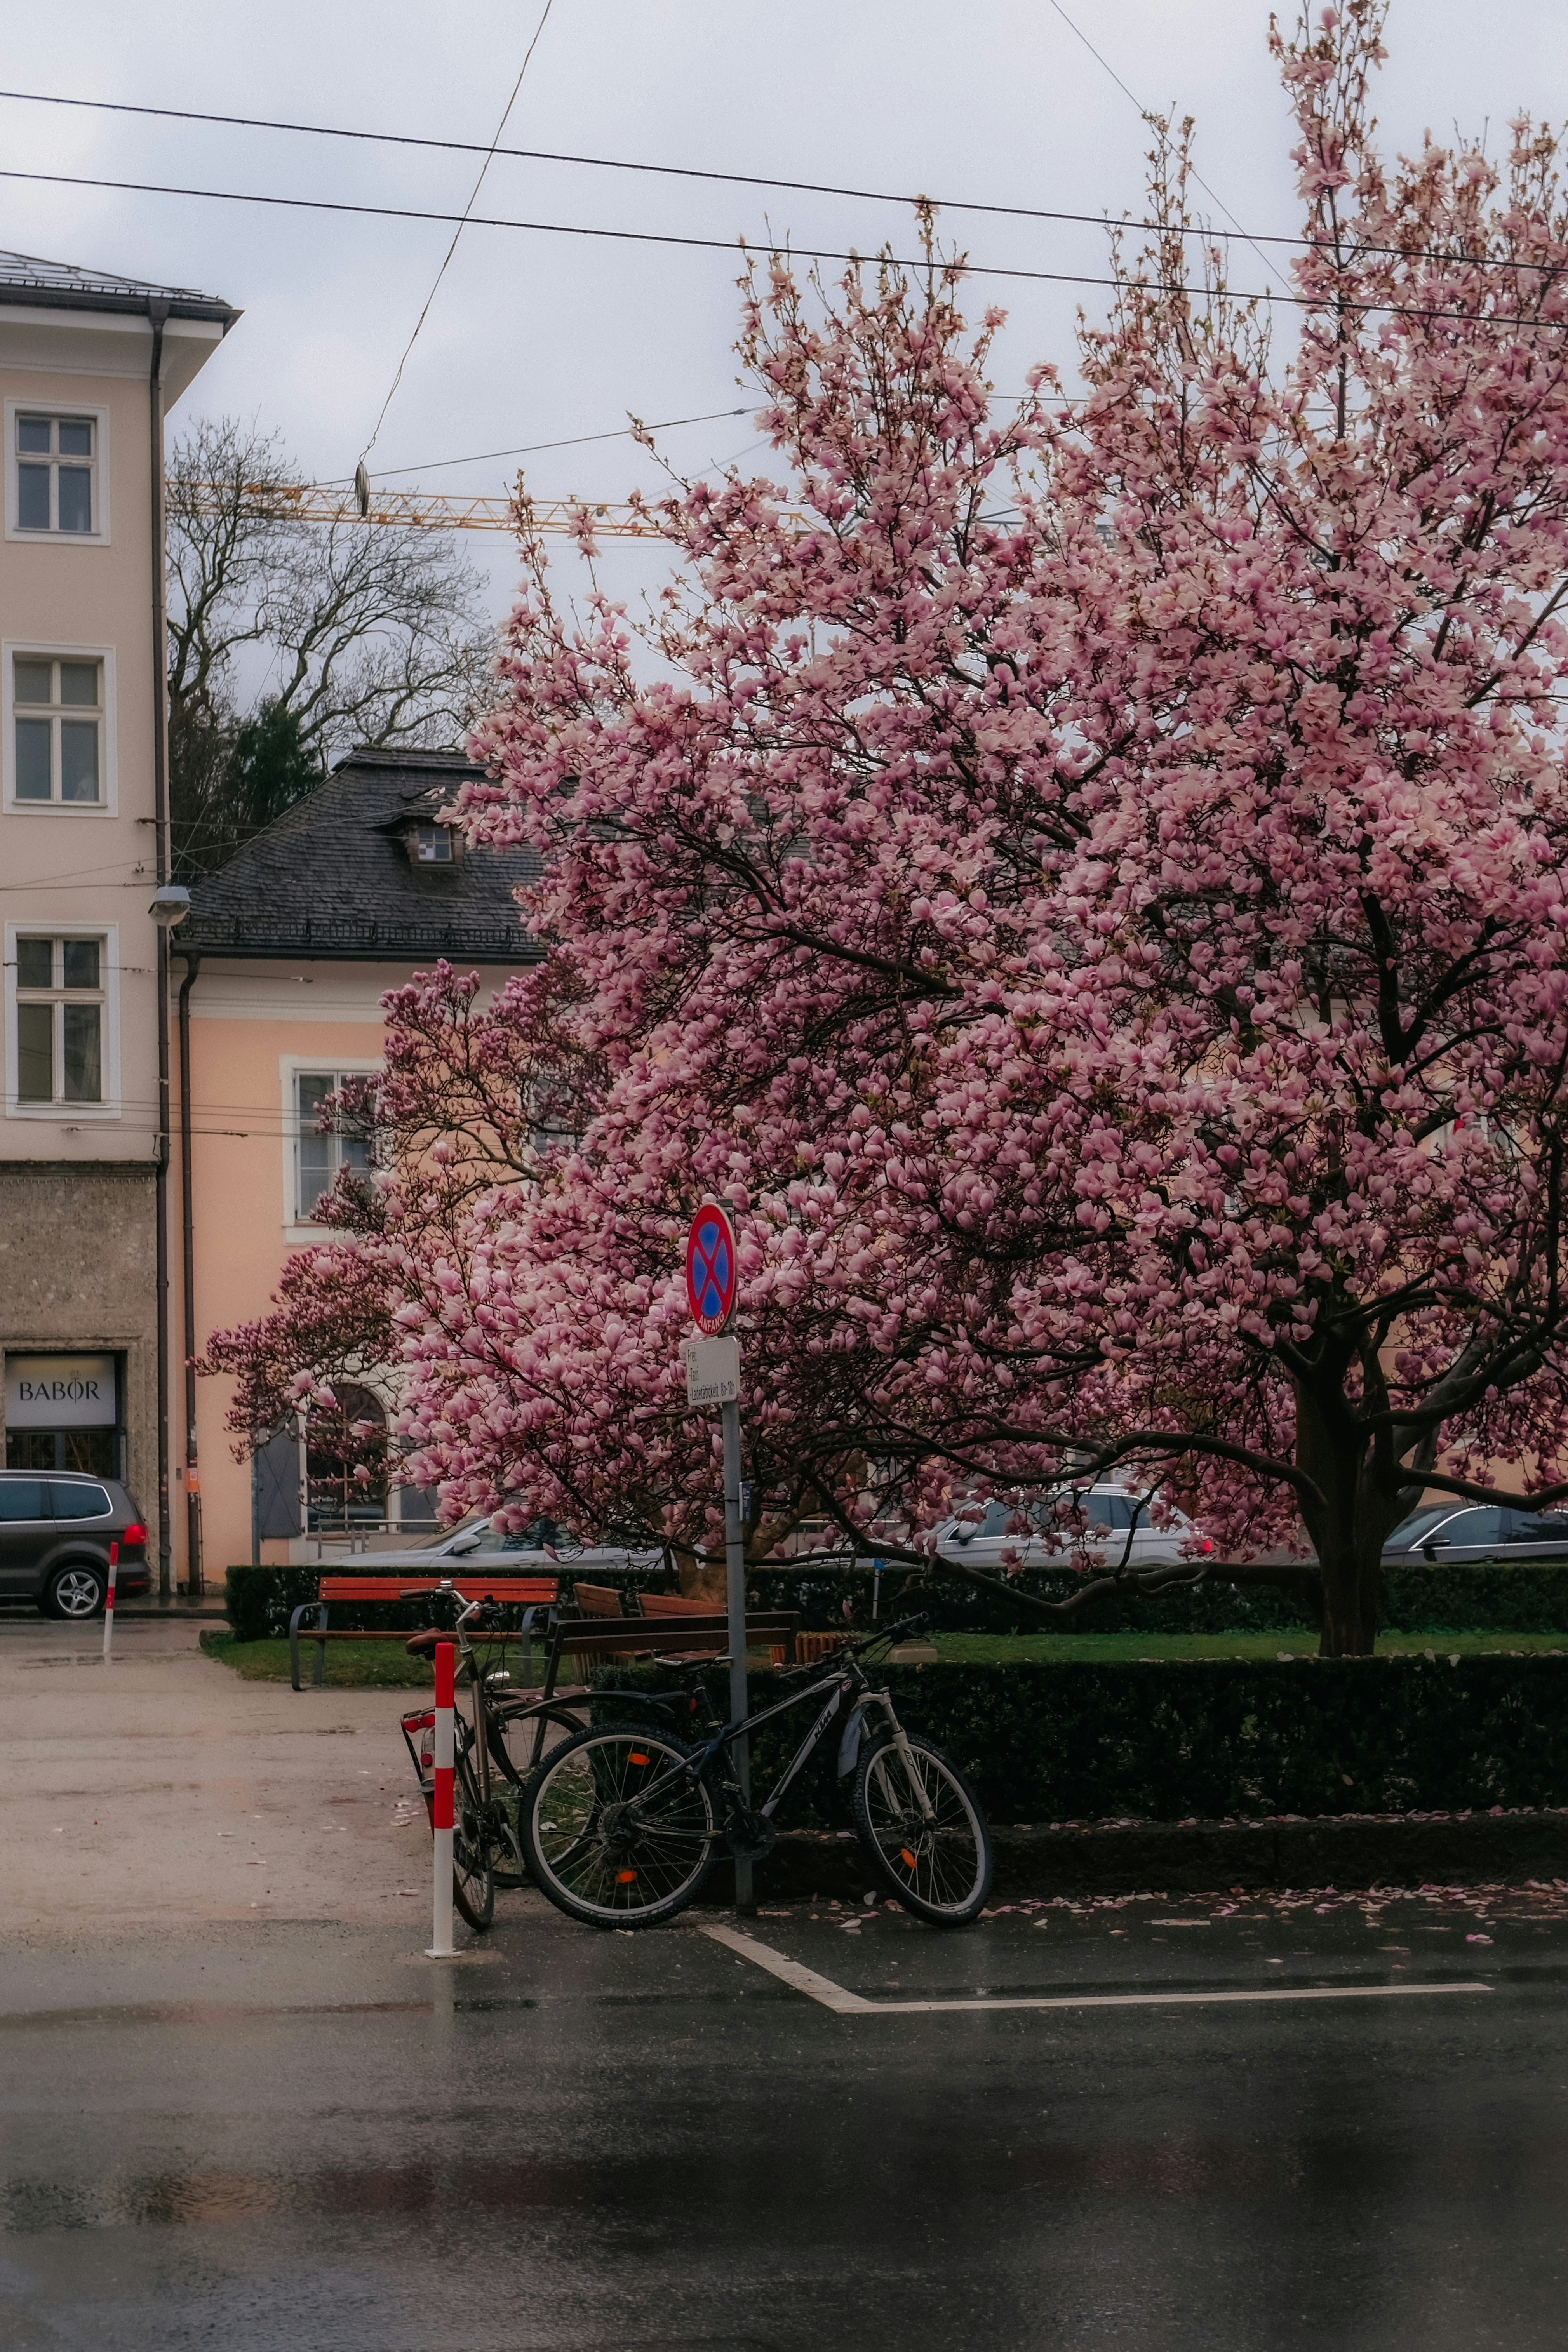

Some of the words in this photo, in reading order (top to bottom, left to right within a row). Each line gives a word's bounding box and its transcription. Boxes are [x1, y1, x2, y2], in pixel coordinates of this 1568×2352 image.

[698, 1310, 724, 1332] ANFANG
[20, 1378, 100, 1404] BABOR
[814, 1709, 832, 1740] KTM
